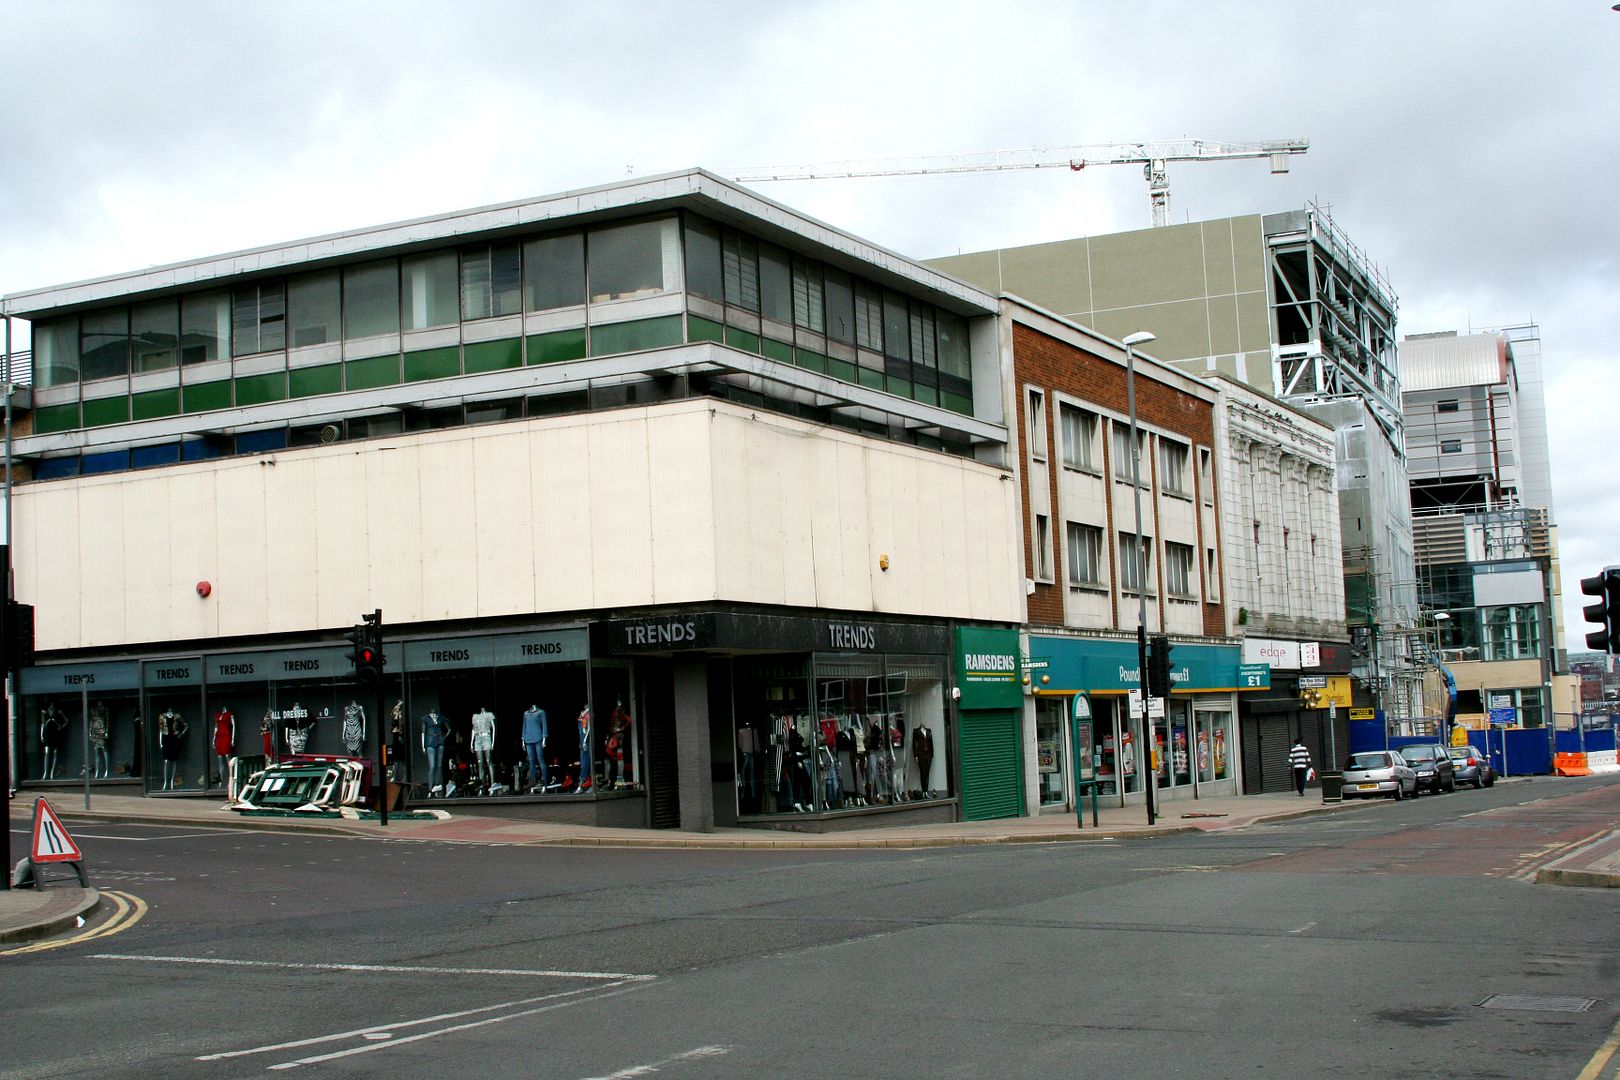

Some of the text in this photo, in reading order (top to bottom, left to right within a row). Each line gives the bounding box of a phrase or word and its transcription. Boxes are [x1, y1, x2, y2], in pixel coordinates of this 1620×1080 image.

[625, 622, 696, 645] TRENDS
[828, 624, 875, 649] TRENDS
[430, 649, 469, 663] TRENDS
[521, 643, 562, 656] TRENDS
[1260, 642, 1286, 667] edge
[283, 660, 320, 672] TRENDS
[965, 654, 1015, 671] RAMSDENS
[156, 668, 190, 680] TRENDS
[219, 663, 254, 676] TRENDS
[63, 673, 95, 685] TRENDS
[1247, 675, 1260, 687] £1
[283, 709, 308, 719] DRESSES
